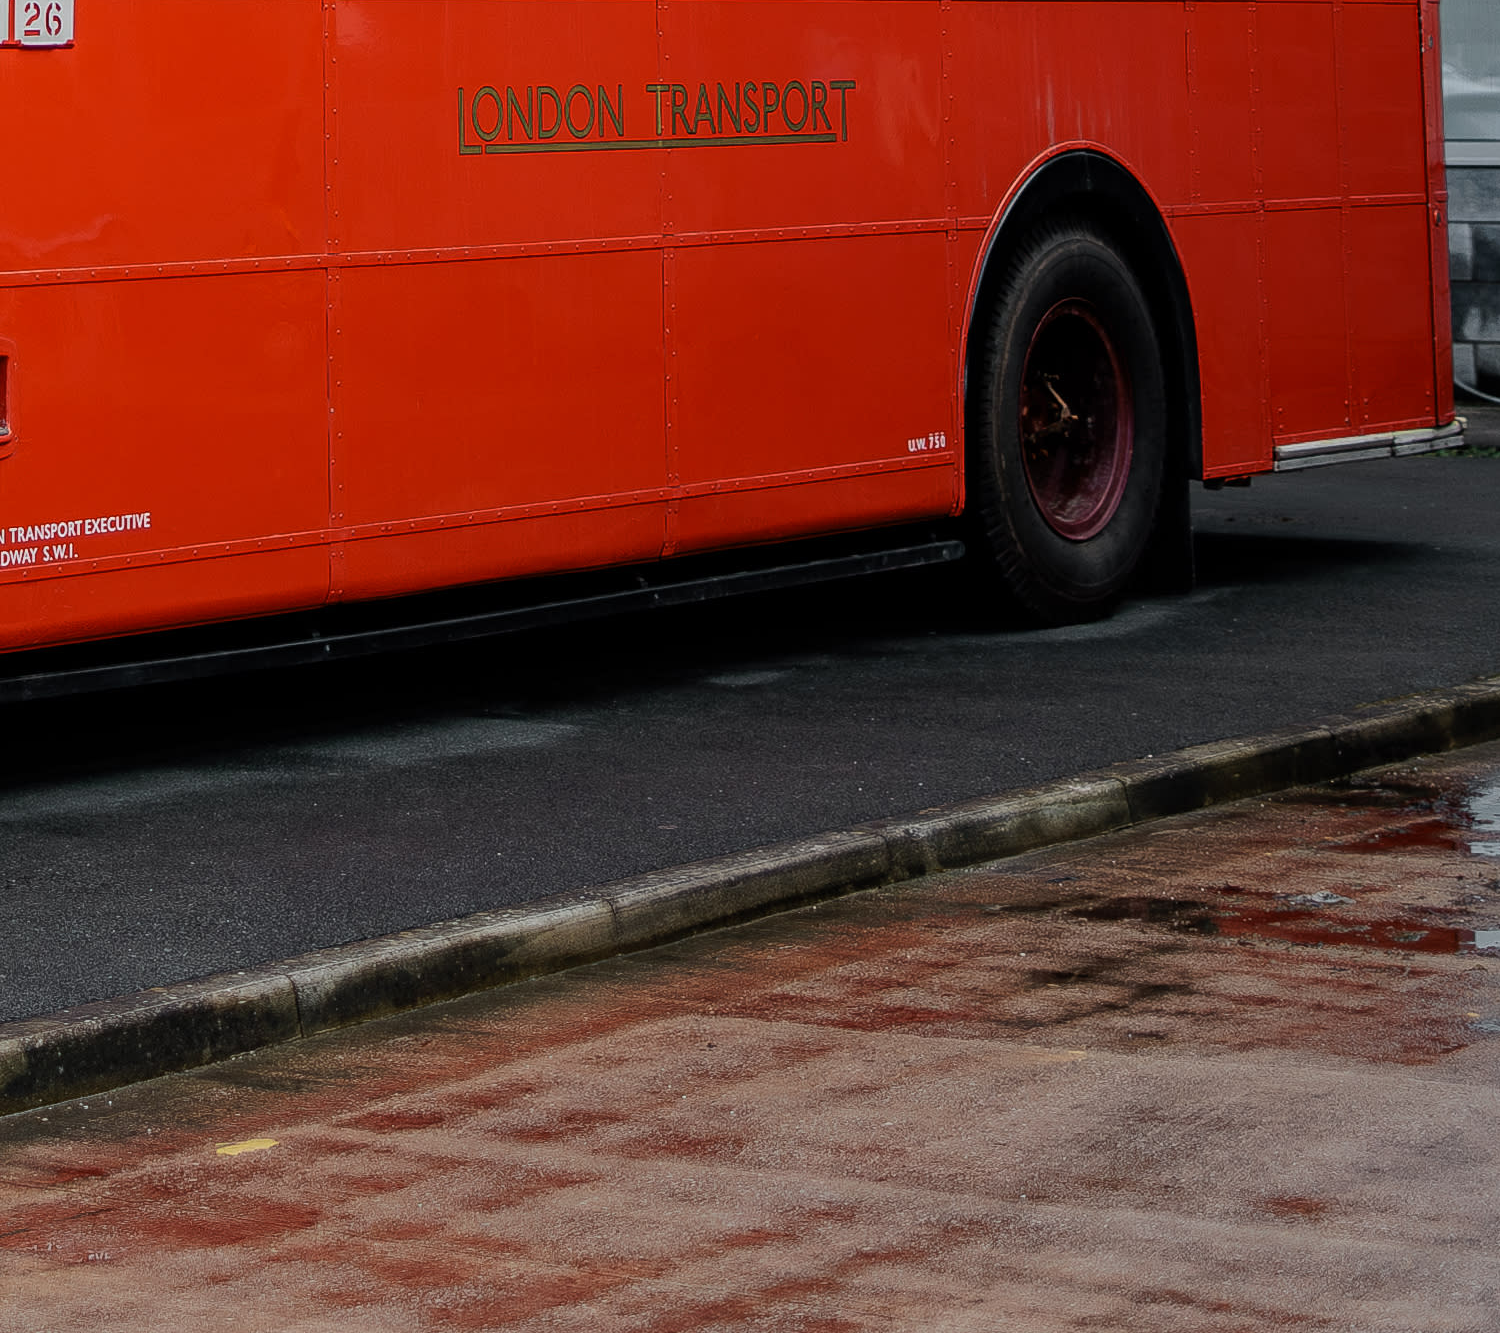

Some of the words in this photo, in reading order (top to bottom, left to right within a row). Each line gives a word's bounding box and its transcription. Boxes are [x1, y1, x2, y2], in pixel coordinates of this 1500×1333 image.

[24, 2, 62, 36] 26
[457, 83, 625, 155] LONDON
[645, 80, 857, 143] TRANSPORT
[8, 519, 83, 543] TRANSPORT
[84, 512, 152, 536] EXECUTIVE
